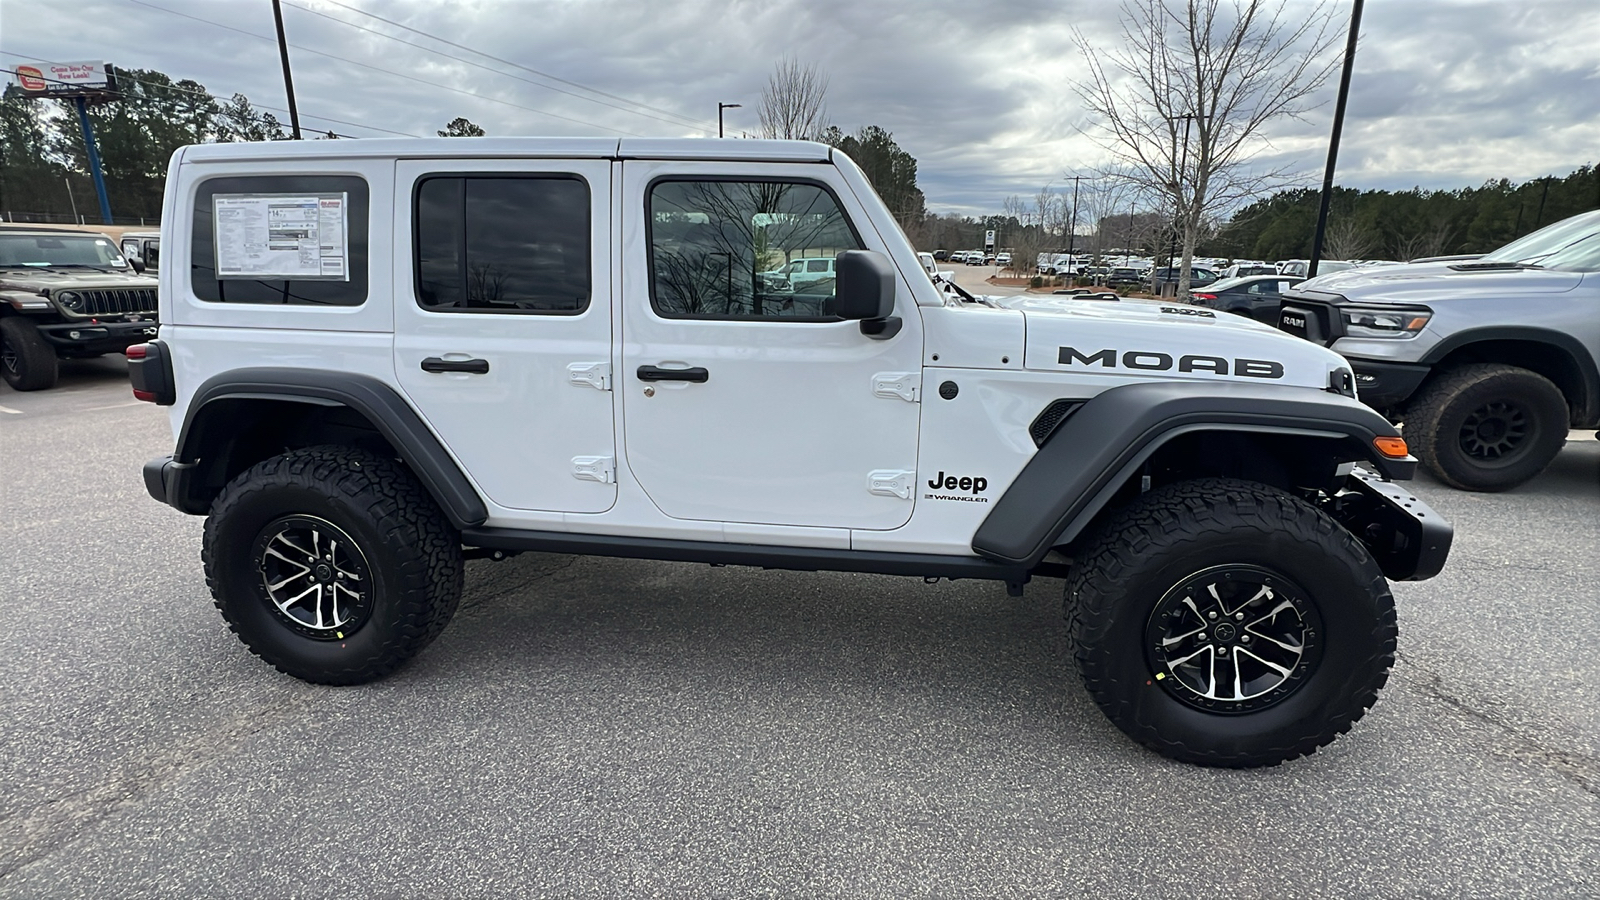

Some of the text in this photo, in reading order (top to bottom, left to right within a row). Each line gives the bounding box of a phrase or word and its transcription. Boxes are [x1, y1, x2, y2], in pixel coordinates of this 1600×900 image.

[1283, 316, 1305, 328] RAM
[1058, 346, 1285, 379] MOAB
[927, 470, 988, 495] Jeep
[934, 494, 988, 503] WRANGLER
